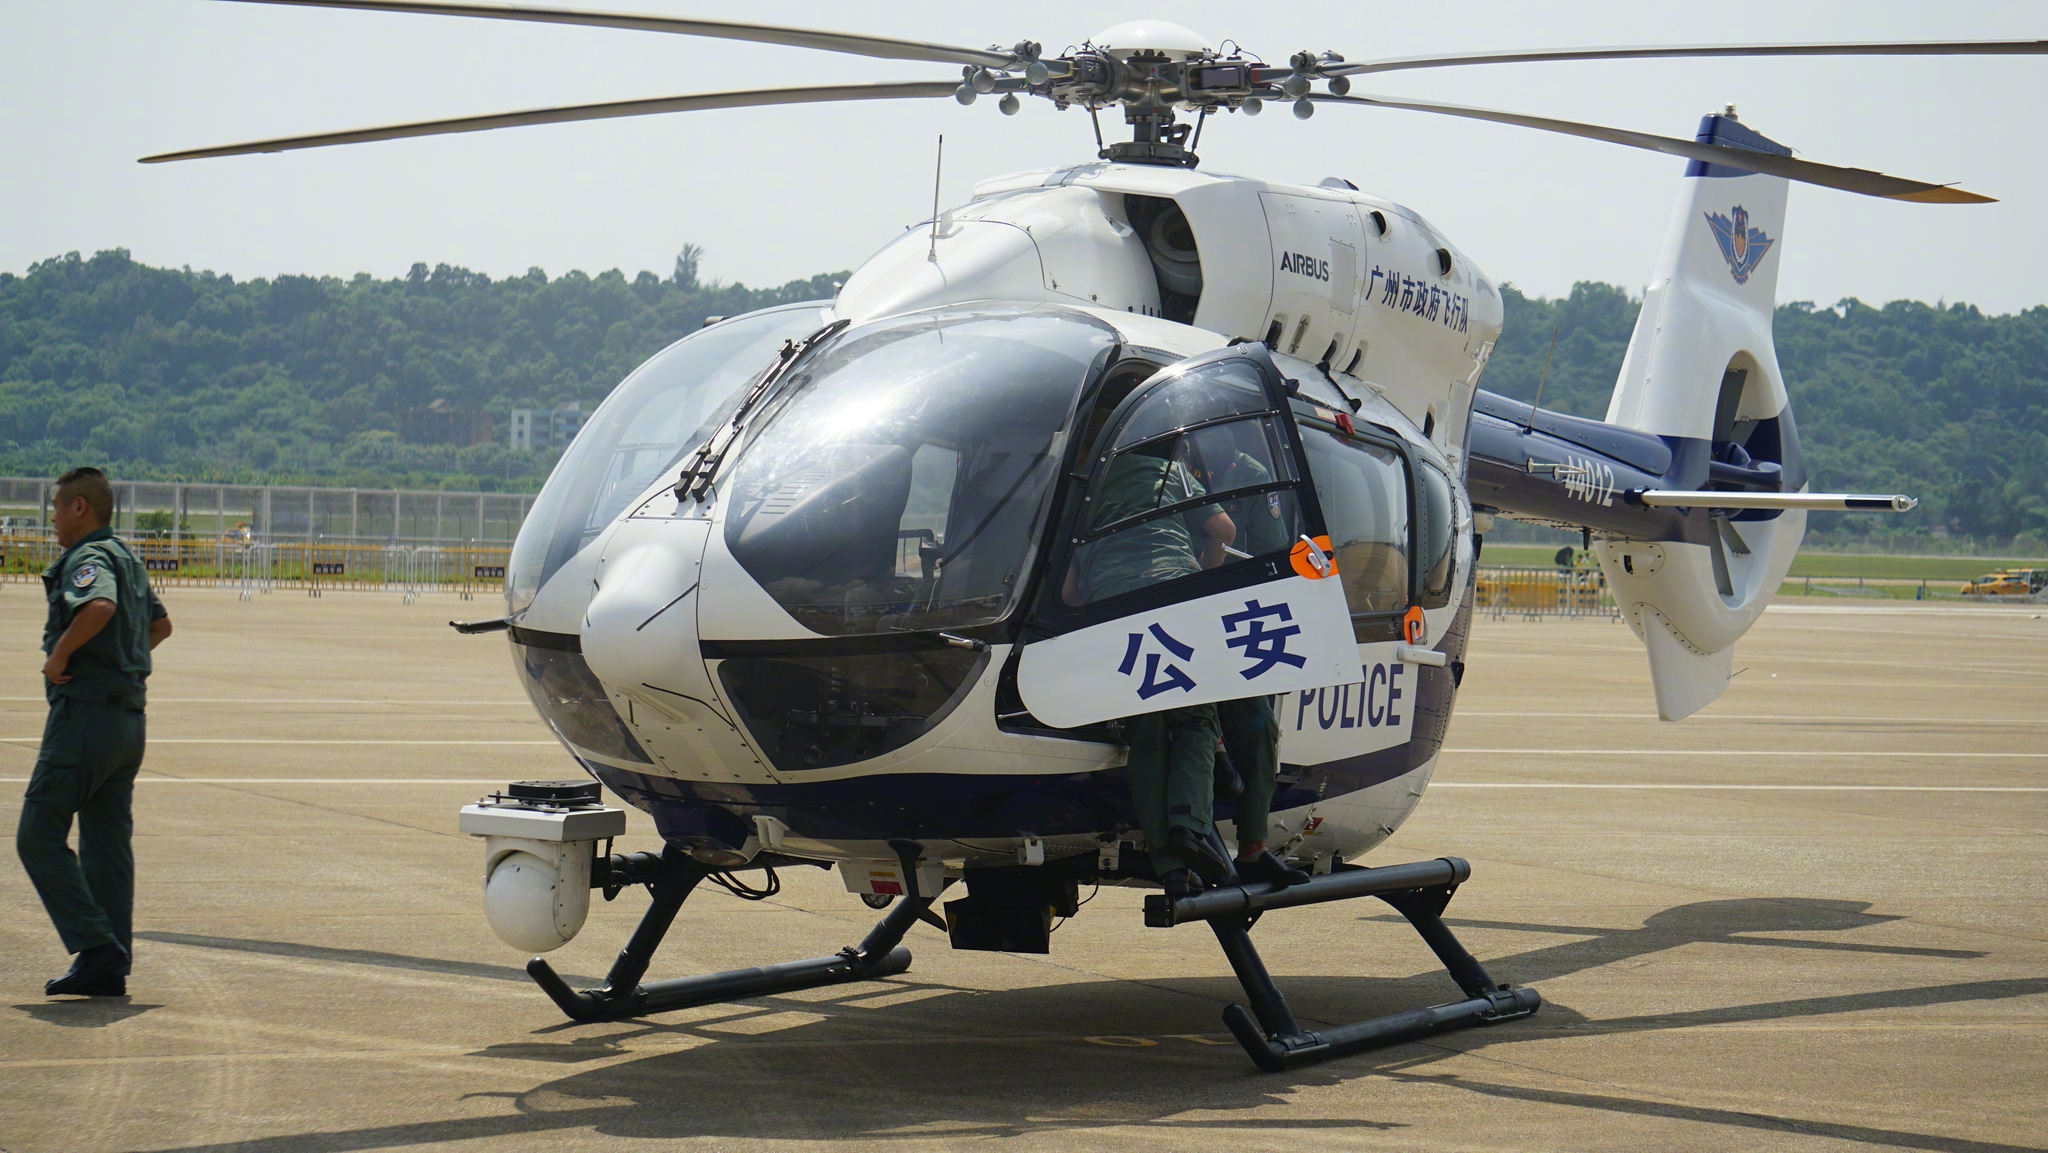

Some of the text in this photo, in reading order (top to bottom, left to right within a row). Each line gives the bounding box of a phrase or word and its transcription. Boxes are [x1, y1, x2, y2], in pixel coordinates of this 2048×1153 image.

[1280, 251, 1329, 282] AIRBUS
[1365, 264, 1469, 335] 广州市政府飞行队
[1564, 455, 1614, 507] 44012
[1117, 599, 1307, 701] 公安
